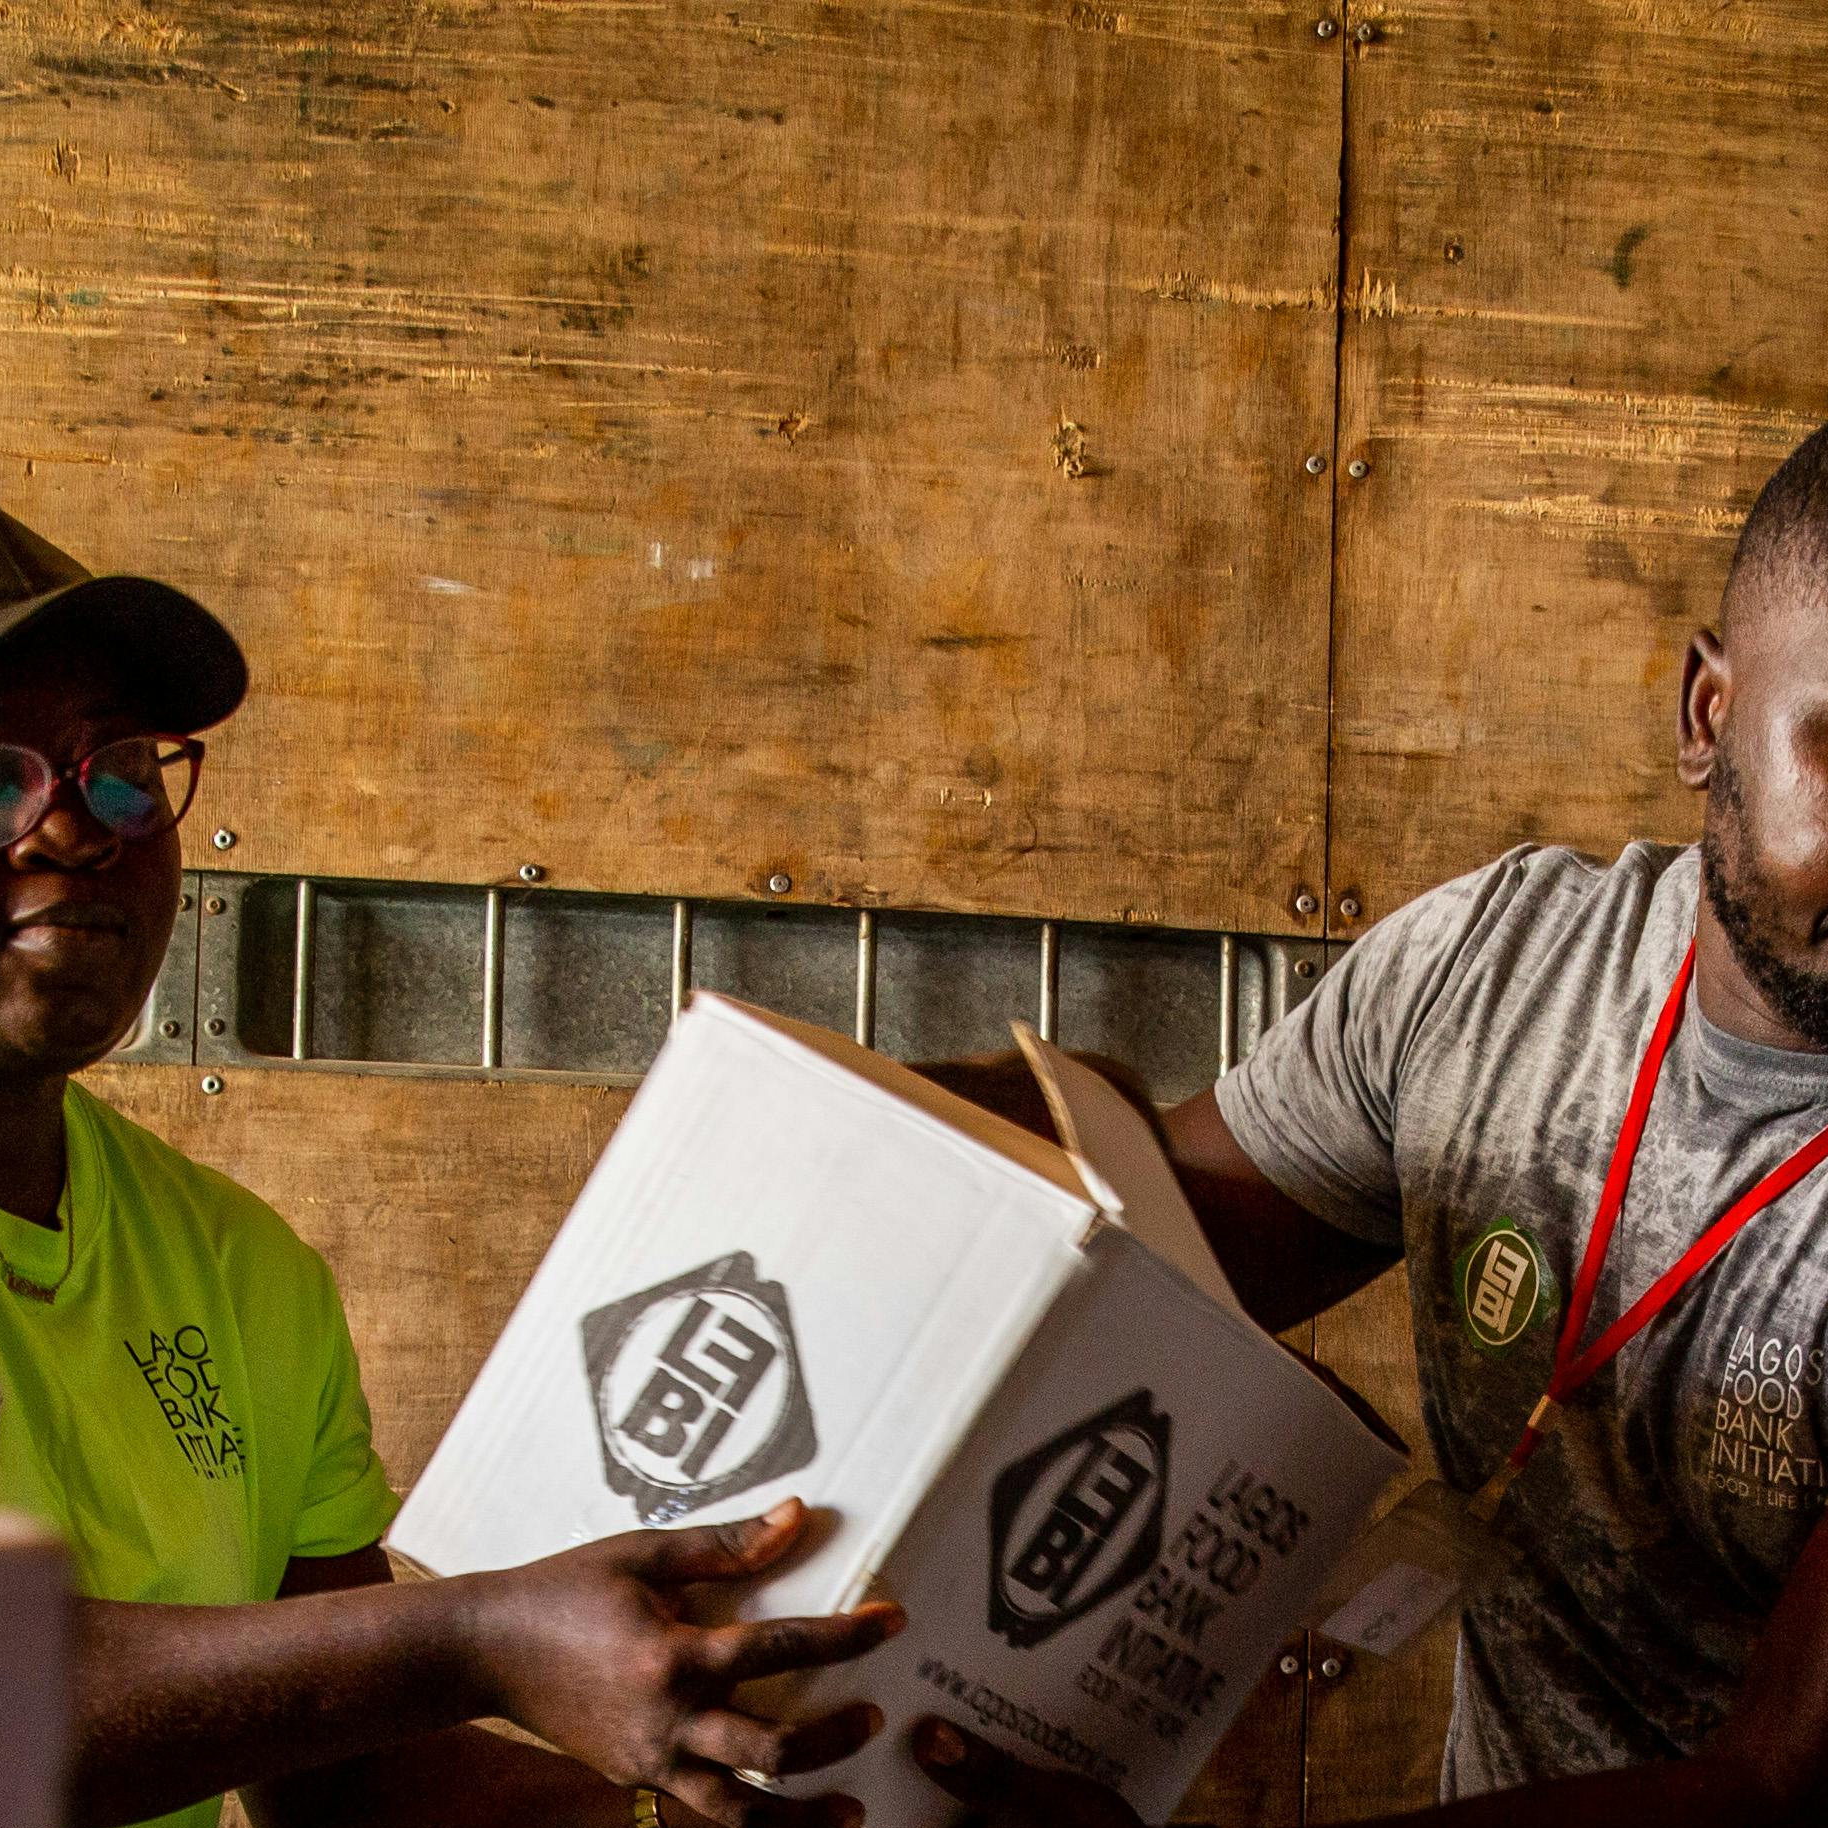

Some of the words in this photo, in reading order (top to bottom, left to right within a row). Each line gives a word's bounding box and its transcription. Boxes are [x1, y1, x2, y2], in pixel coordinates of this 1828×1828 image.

[1729, 1326, 1824, 1386] LAGOS
[1721, 1362, 1802, 1420] FOOD
[1716, 1398, 1793, 1454] BANK
[1208, 1459, 1310, 1557] LAGOS
[1708, 1471, 1750, 1497] FOOD
[1171, 1511, 1263, 1597] FOOD
[1134, 1563, 1224, 1645] BANK
